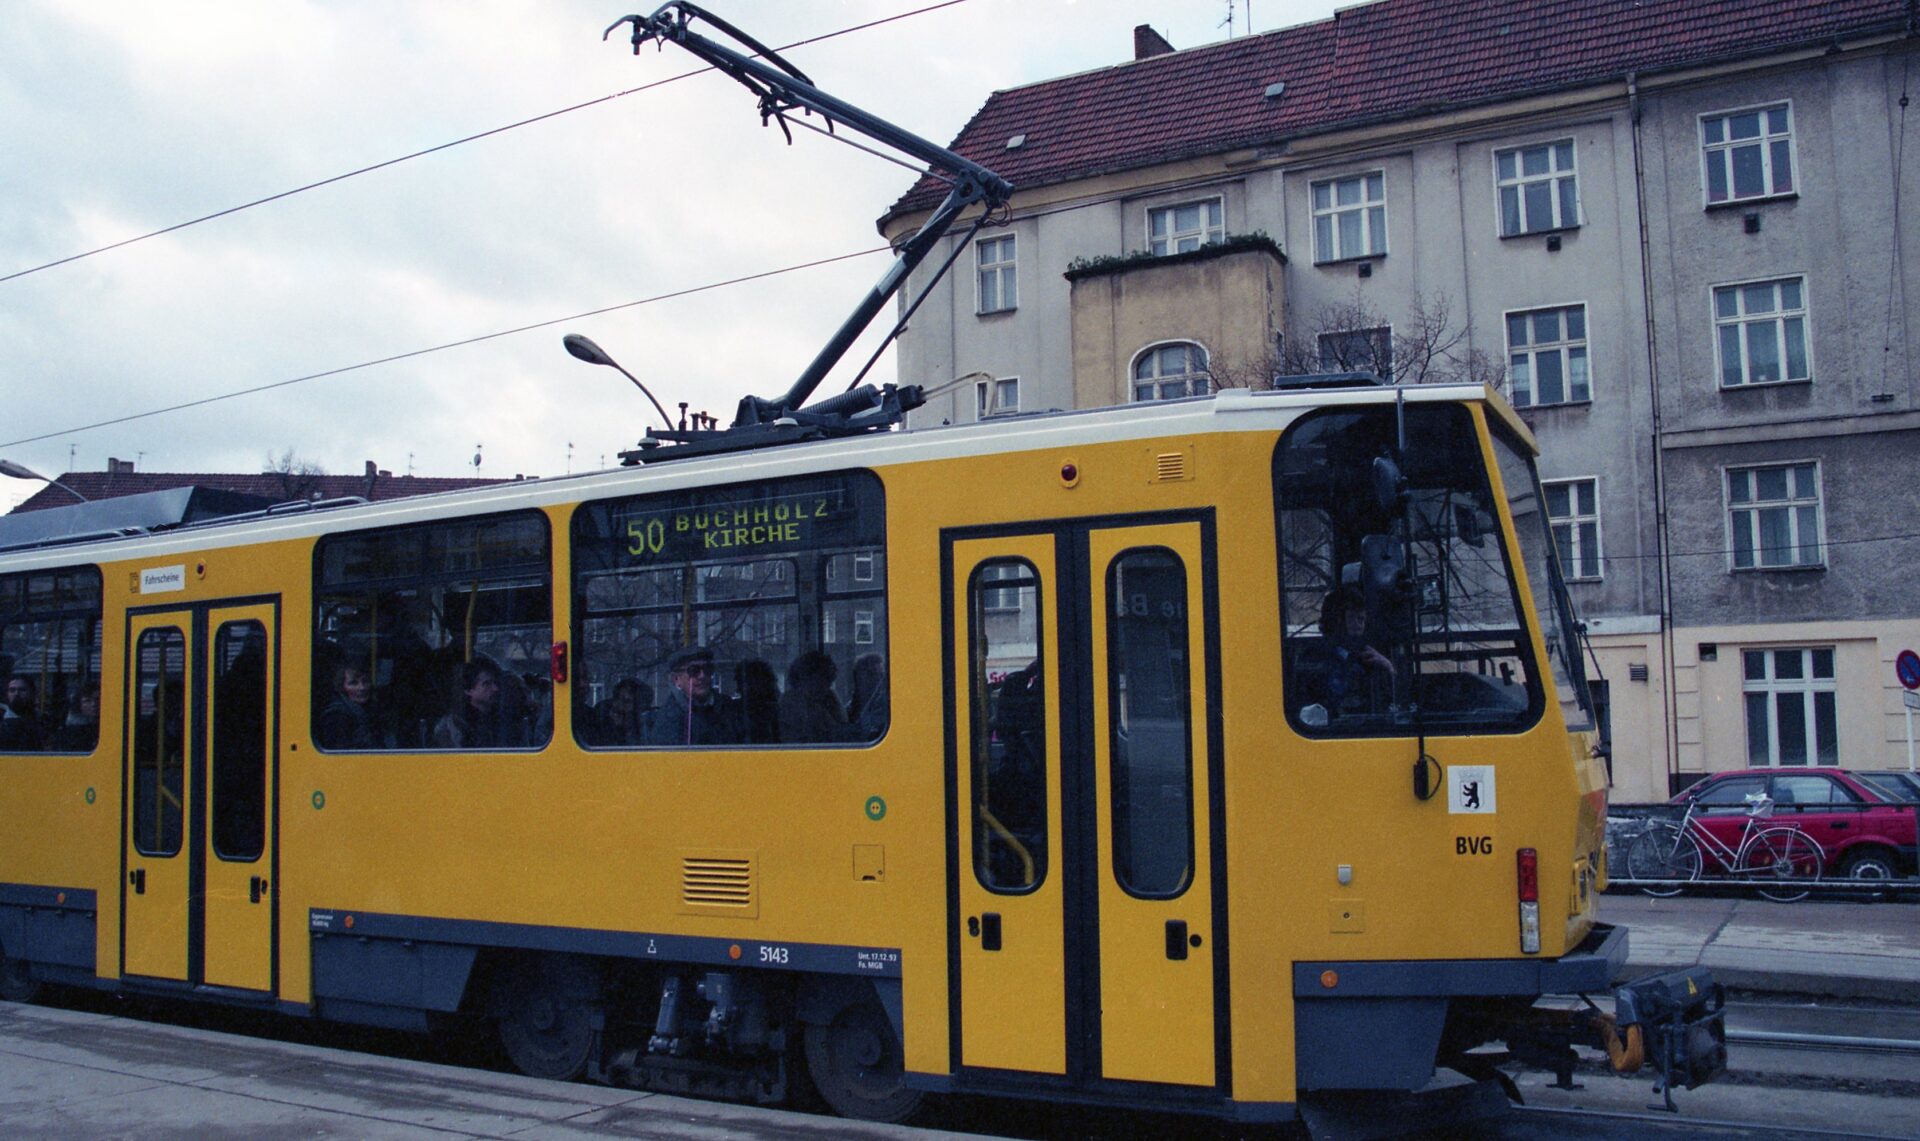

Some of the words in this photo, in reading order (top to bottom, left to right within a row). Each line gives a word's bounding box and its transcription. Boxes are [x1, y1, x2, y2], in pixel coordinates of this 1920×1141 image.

[627, 518, 665, 555] 50
[675, 498, 828, 532] BUCHHOLZ
[703, 522, 801, 549] KIRCHE
[145, 573, 179, 584] Fahrscheine
[1456, 836, 1492, 855] BVG
[759, 945, 788, 964] 5143
